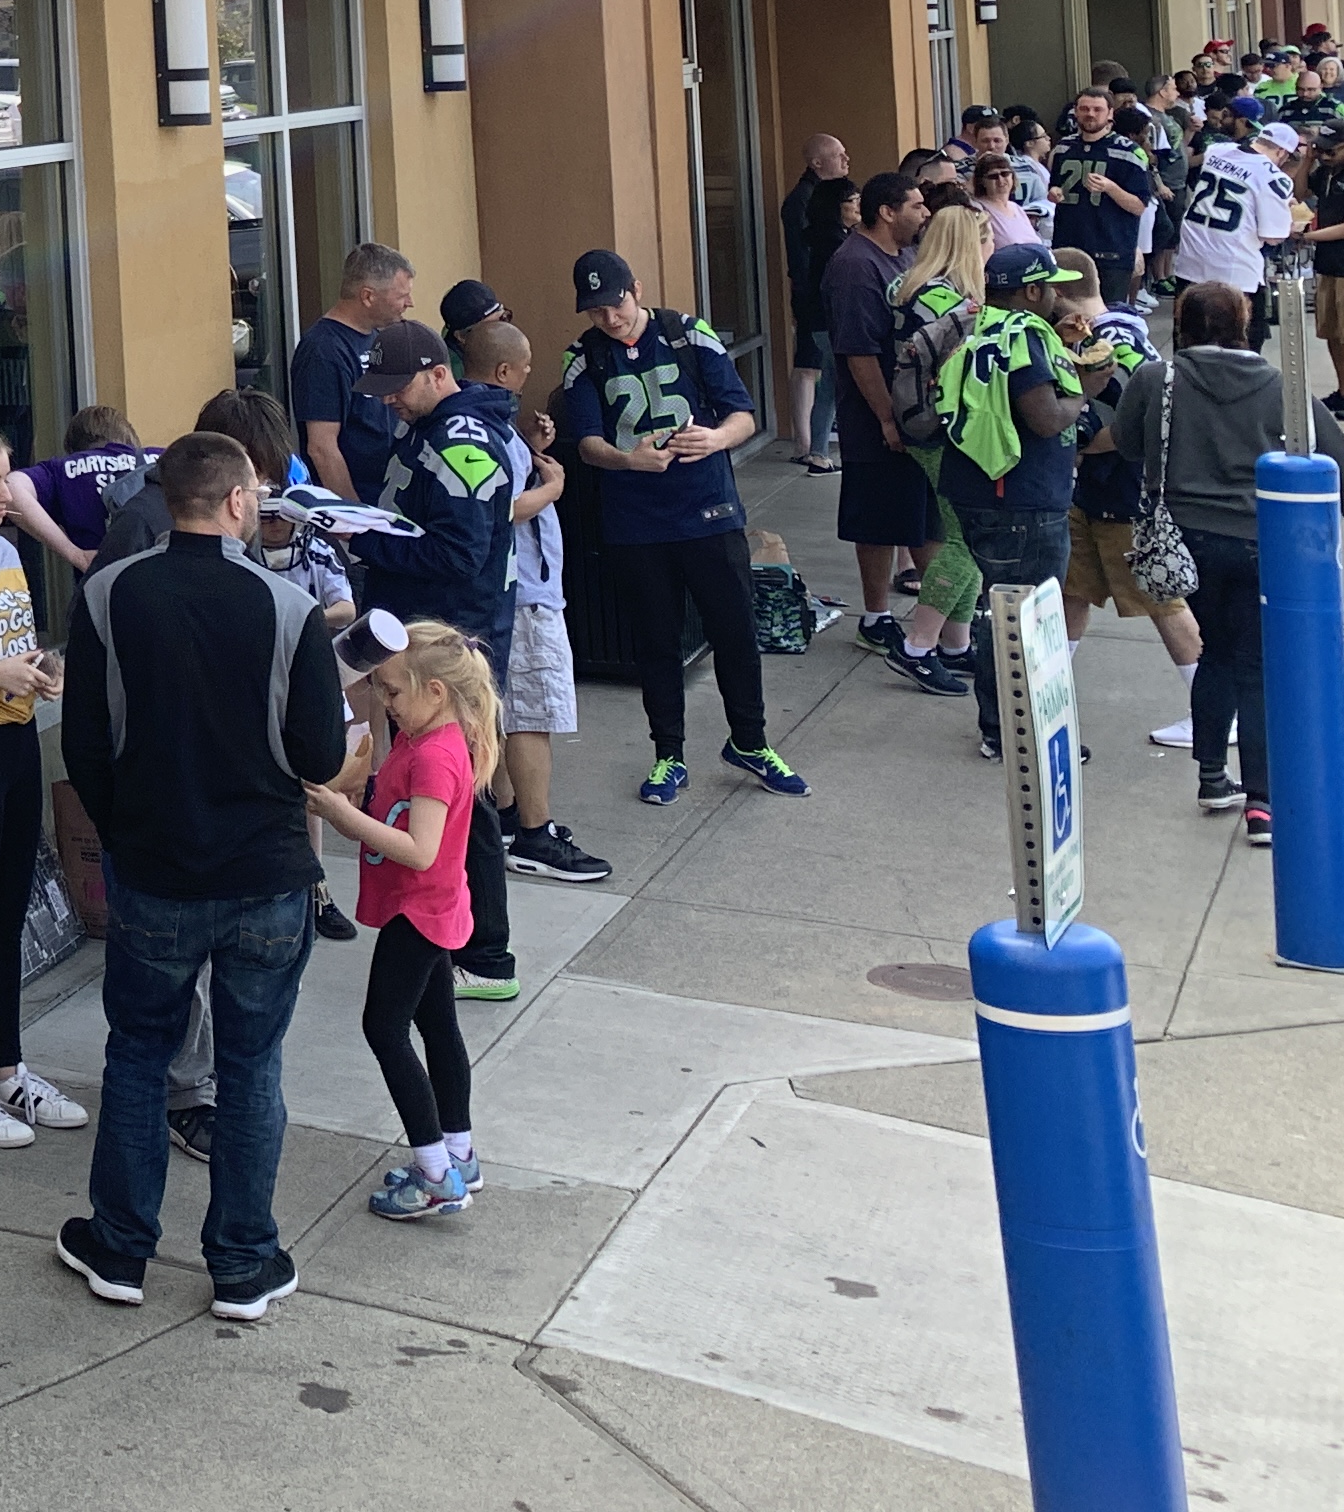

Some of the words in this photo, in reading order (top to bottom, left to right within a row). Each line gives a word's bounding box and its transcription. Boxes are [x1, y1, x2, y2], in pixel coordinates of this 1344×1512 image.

[1060, 159, 1107, 206] 24
[1206, 155, 1252, 181] SHERMAN
[1185, 171, 1247, 232] 25
[1100, 326, 1136, 345] 25
[605, 363, 693, 454] 25
[445, 414, 489, 443] 25
